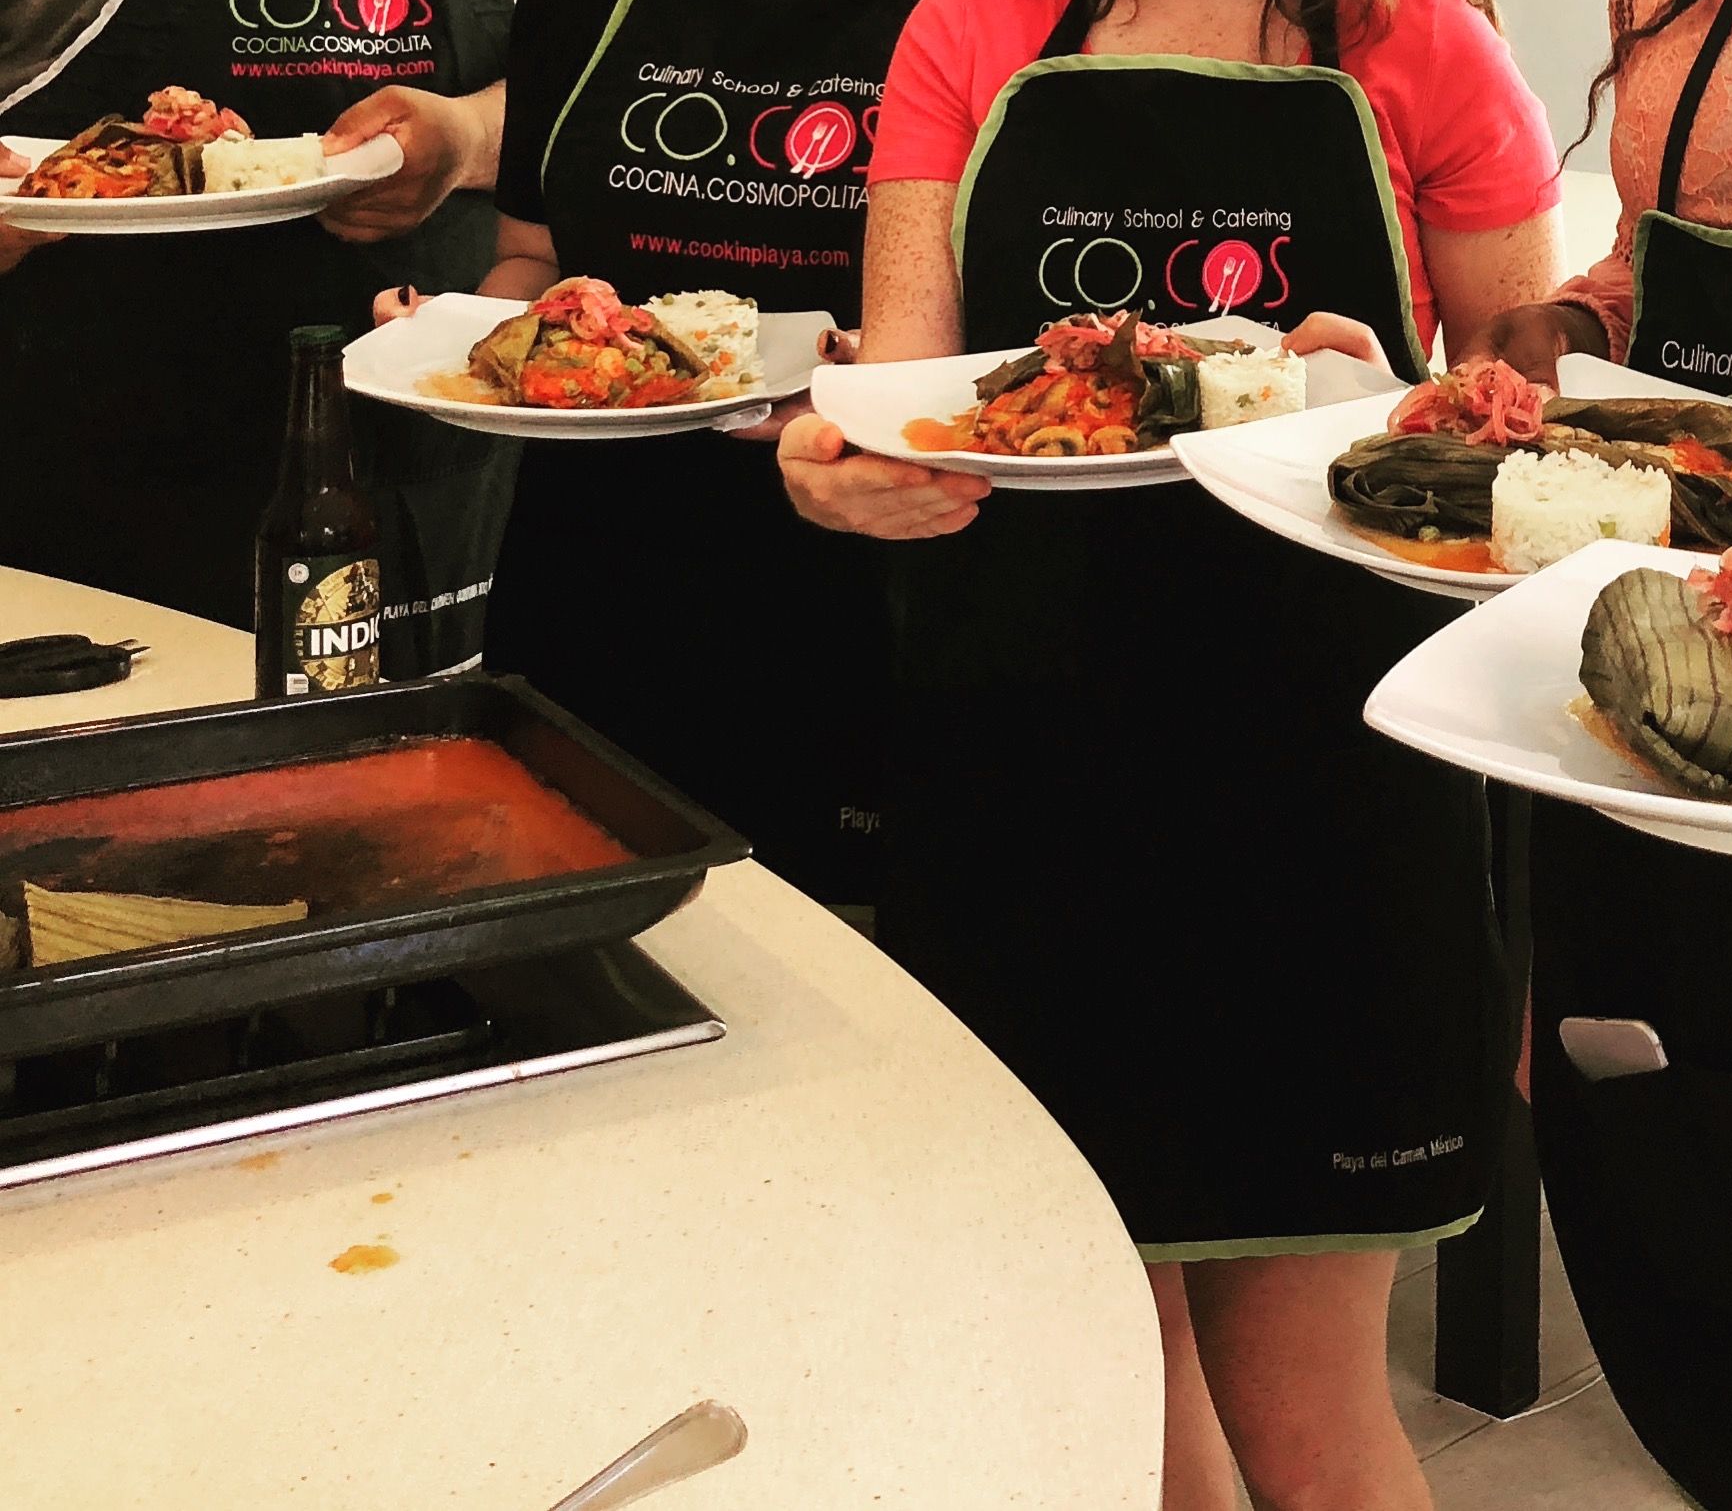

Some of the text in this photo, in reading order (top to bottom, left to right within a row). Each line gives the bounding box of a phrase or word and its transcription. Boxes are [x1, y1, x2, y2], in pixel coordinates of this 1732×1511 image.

[230, 57, 435, 80] www.cookinplaya.com
[638, 62, 705, 88] Culinary
[711, 70, 780, 96] School
[787, 84, 804, 98] &
[1042, 206, 1292, 232] Culinary School & Catering
[630, 232, 850, 270] www.cookinplaya.com
[383, 603, 410, 620] PLAYA
[1333, 1152, 1365, 1173] Playa
[1370, 1151, 1388, 1169] del
[1430, 1134, 1464, 1157] México
